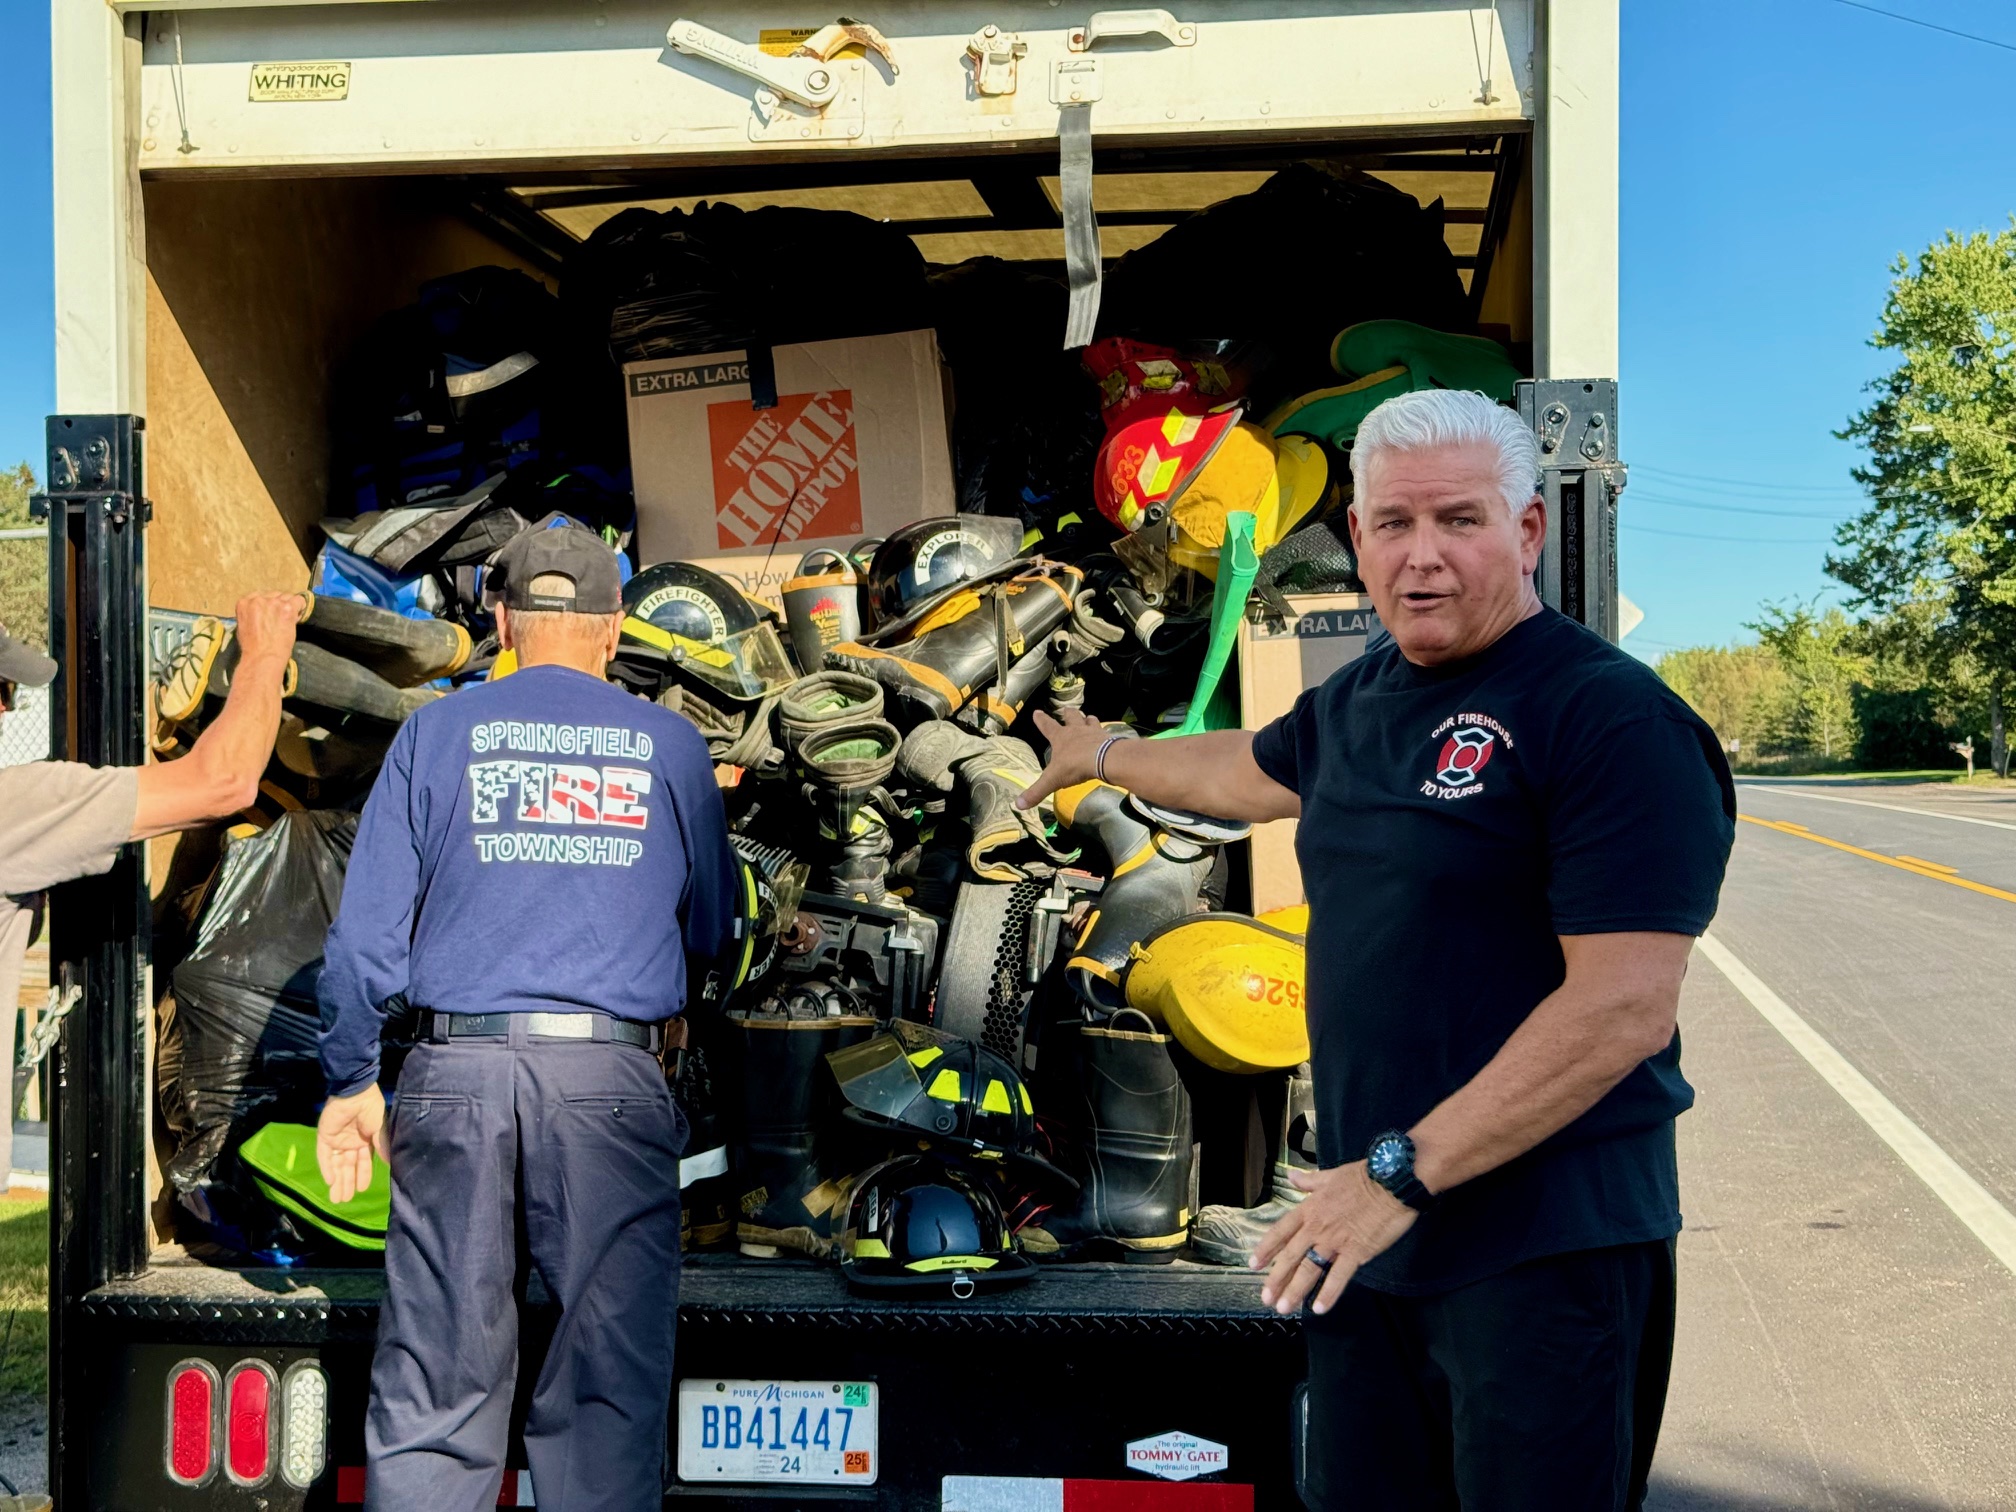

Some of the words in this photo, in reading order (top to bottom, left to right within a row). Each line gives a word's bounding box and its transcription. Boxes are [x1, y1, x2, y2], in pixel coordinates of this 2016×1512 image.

[255, 73, 346, 90] WHITING
[636, 371, 699, 392] EXTRA
[724, 412, 784, 474] THE
[716, 391, 854, 547] HOME
[1111, 444, 1145, 495] 633
[774, 442, 858, 542] DEPOT
[917, 532, 985, 570] EXPLORER
[745, 571, 788, 587] How
[642, 588, 724, 636] FIREFIGHTER
[471, 720, 654, 762] SPRINGFIELD
[1431, 716, 1456, 739] OUR
[1457, 713, 1514, 750] FIREHOUSE
[469, 760, 652, 830] FIRE
[1420, 780, 1437, 796] TO
[1437, 783, 1484, 800] YOURS
[475, 832, 643, 867] TOWNSHIP
[733, 1389, 759, 1398] PURE
[755, 1383, 825, 1406] MICHIGAN
[845, 1385, 862, 1398] 24
[702, 1405, 854, 1451] BB41447
[846, 1453, 862, 1465] 25
[1130, 1449, 1183, 1462] TOMMY
[1187, 1450, 1222, 1462] GATE
[1172, 1440, 1198, 1449] original
[779, 1456, 802, 1474] 24
[1155, 1463, 1189, 1472] hydraulic
[1190, 1464, 1200, 1472] lift
